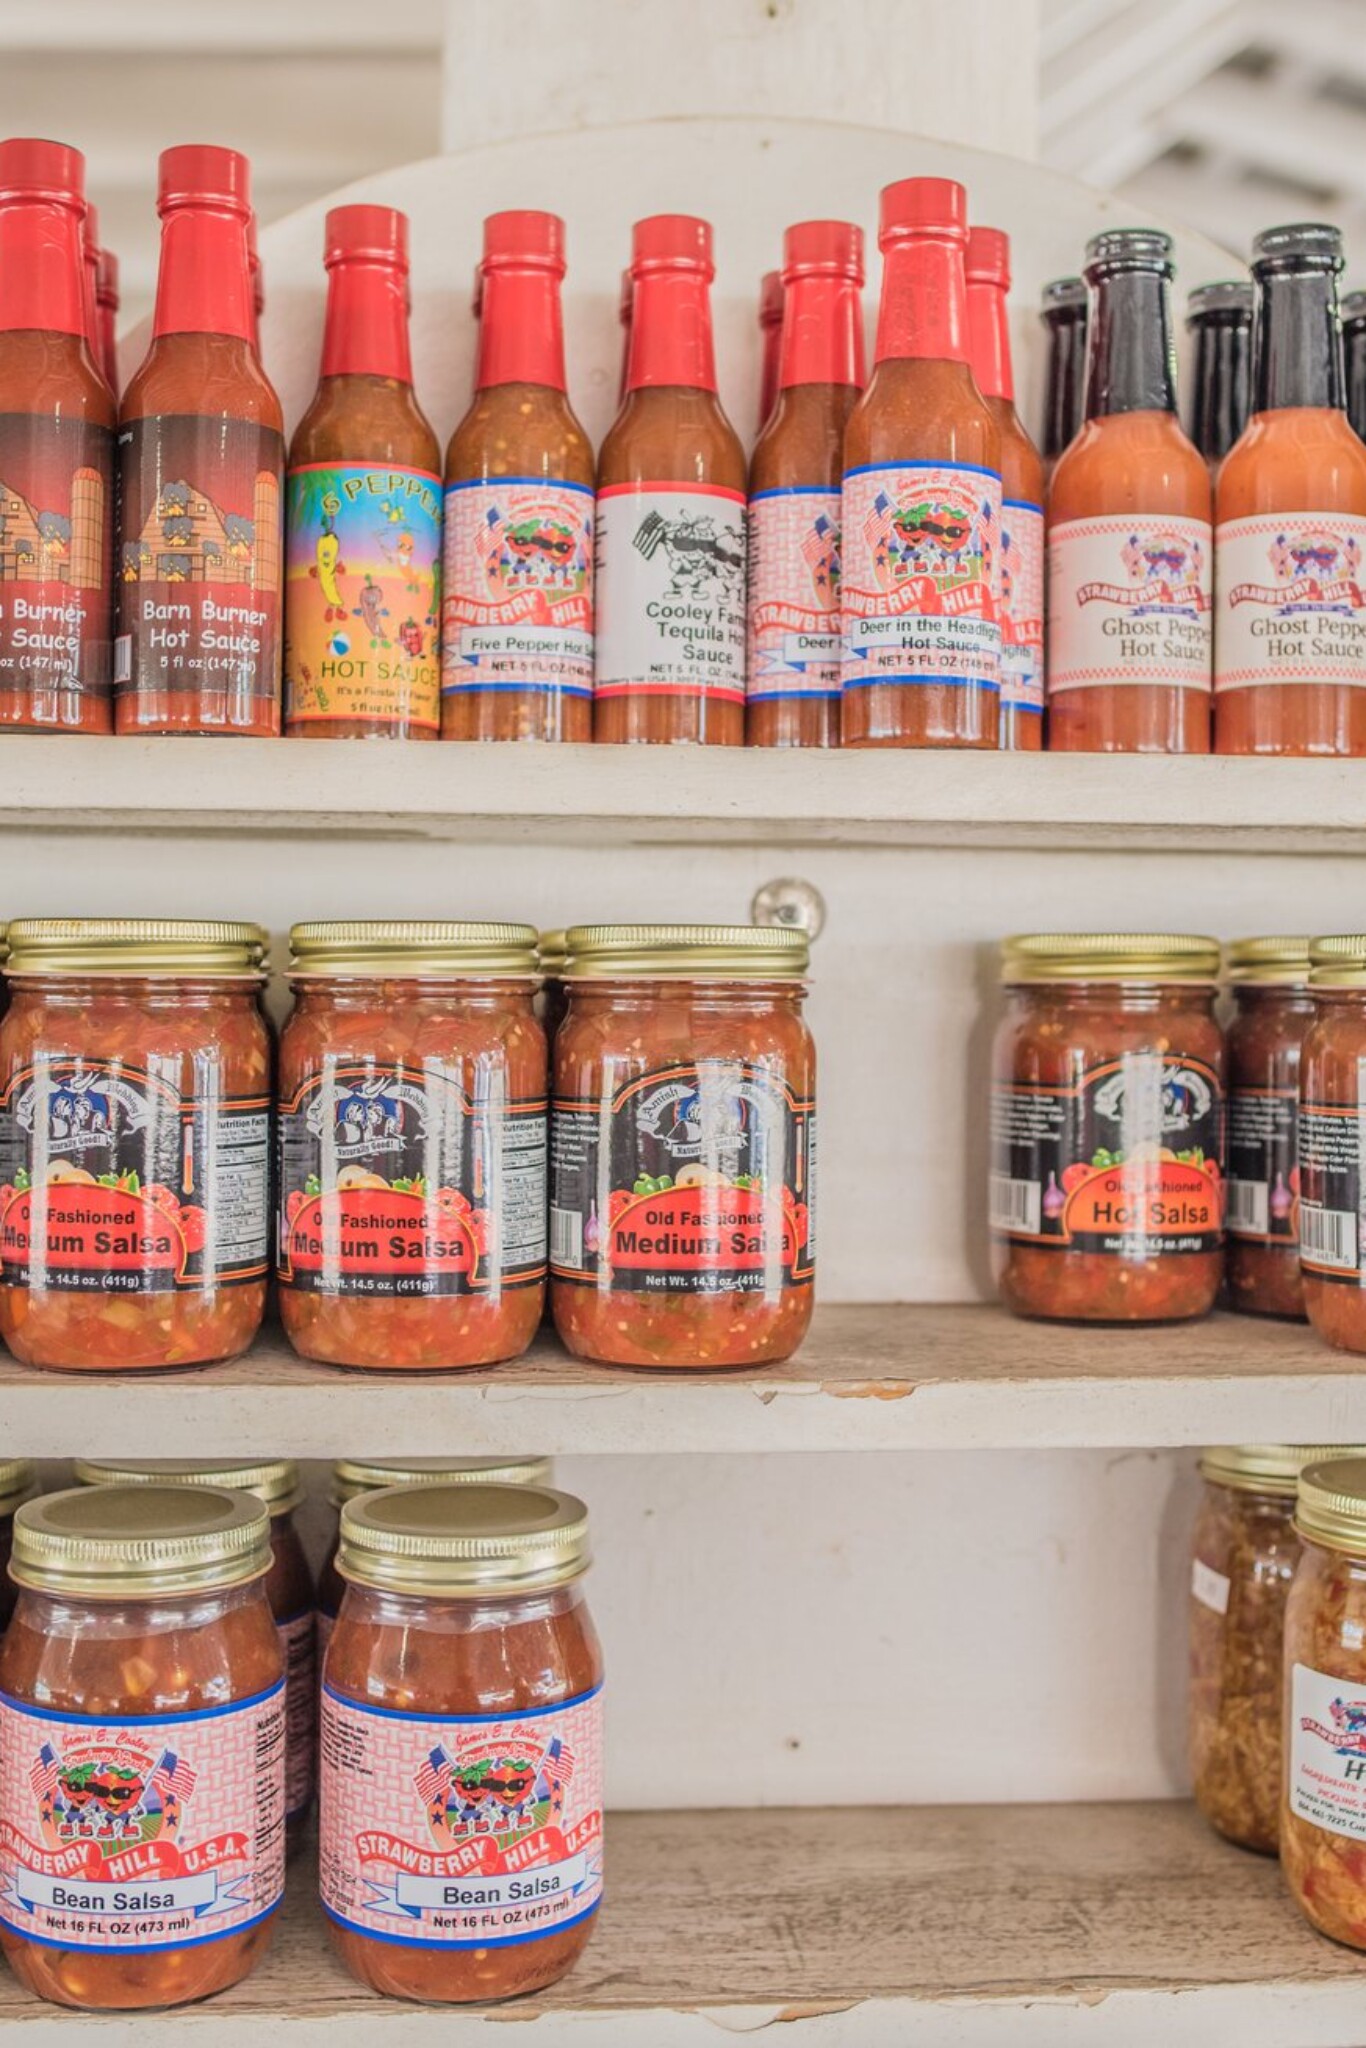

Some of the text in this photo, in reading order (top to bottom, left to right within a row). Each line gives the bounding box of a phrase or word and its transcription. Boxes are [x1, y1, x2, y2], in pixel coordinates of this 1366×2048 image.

[322, 491, 342, 517] 6
[13, 598, 87, 622] Burner
[941, 585, 983, 614] HILL
[143, 600, 268, 627] Barn Burner
[646, 602, 713, 624] Cooley
[657, 622, 745, 647] Tequila Ho
[860, 621, 890, 635] Deer
[896, 619, 912, 633] in
[917, 619, 942, 632] the
[1102, 618, 1211, 643] Ghost Peppe
[1250, 618, 1308, 637] Ghost
[11, 627, 80, 650] Sauce
[150, 627, 262, 654] Hot Sauce
[471, 638, 502, 651] Five
[506, 637, 561, 652] Pepper
[798, 636, 834, 649] Deer
[902, 637, 981, 654] Hot Sauce
[1268, 637, 1364, 659] Hot Sauce
[683, 644, 734, 665] Sauce
[1120, 639, 1205, 661] Hot Sauce
[160, 655, 169, 669] 5
[173, 655, 184, 668] fl
[491, 661, 516, 672] NET
[550, 662, 567, 674] OZ
[650, 664, 673, 673] NET
[878, 656, 903, 667] NET
[908, 656, 915, 666] 5
[919, 656, 935, 666] FL
[939, 657, 957, 667] OZ
[321, 661, 438, 688] HOT SAUCE
[48, 1207, 136, 1226] Fashioned
[341, 1214, 429, 1230] Fashioned
[645, 1211, 674, 1226] Old
[1151, 1202, 1209, 1225] Salsa
[3, 1225, 172, 1254] Meum Salsa
[295, 1231, 464, 1259] Meum Salsa
[616, 1231, 721, 1256] Medium
[56, 1274, 140, 1288] 14.5 oz. (411g)
[351, 1278, 375, 1291] 14.5
[377, 1281, 394, 1291] oz.
[396, 1279, 435, 1293] (411g)
[646, 1275, 666, 1287] Net
[669, 1276, 689, 1287] Wt.
[108, 1846, 161, 1880] HILL
[184, 1837, 240, 1872] U.S.A.
[358, 1835, 488, 1877] STRAWBERRY
[505, 1833, 551, 1871] HILL
[53, 1887, 175, 1910] Bean Salsa
[443, 1874, 562, 1906] Bean Salsa
[46, 1916, 191, 1935] Net 16 FL OZ (473 ml)
[433, 1916, 458, 1929] Net
[462, 1914, 478, 1928] 16
[482, 1913, 499, 1926] FL
[503, 1911, 523, 1925] OZ
[525, 1906, 551, 1924] (473
